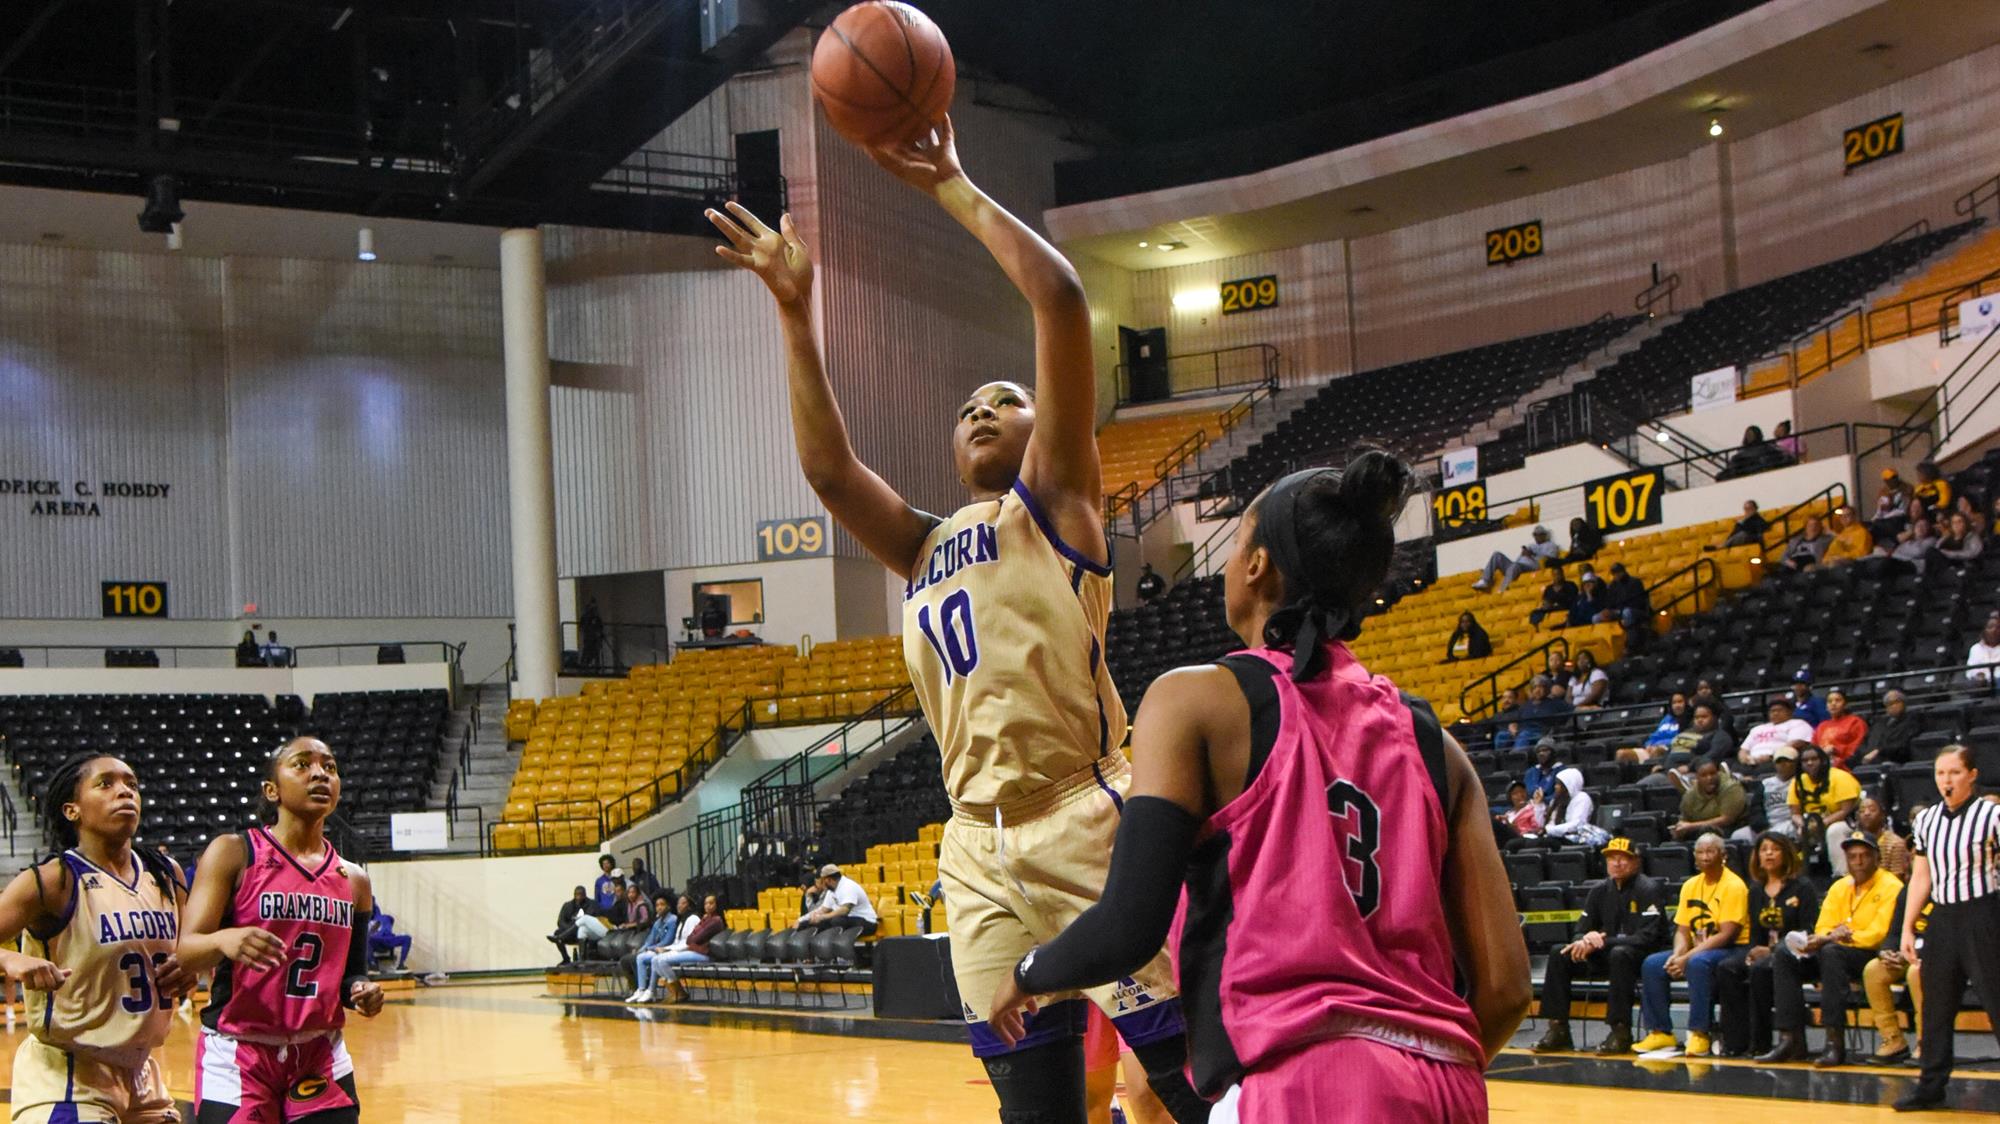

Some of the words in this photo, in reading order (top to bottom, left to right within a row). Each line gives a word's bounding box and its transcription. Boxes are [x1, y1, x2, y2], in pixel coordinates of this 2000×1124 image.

[1844, 116, 1904, 163] 207
[1487, 225, 1542, 262] 208
[1222, 279, 1277, 311] 209
[75, 481, 92, 497] C.
[103, 482, 170, 498] HOBDY
[1433, 486, 1486, 528] 108
[1589, 473, 1656, 529] 107
[30, 500, 100, 517] ARENA
[758, 520, 823, 555] 109
[107, 585, 162, 614] 110
[918, 587, 980, 688] 10
[1325, 778, 1382, 921] 3
[99, 910, 177, 944] ALCORN
[285, 931, 324, 998] 2
[1111, 981, 1152, 1001] ALCORN
